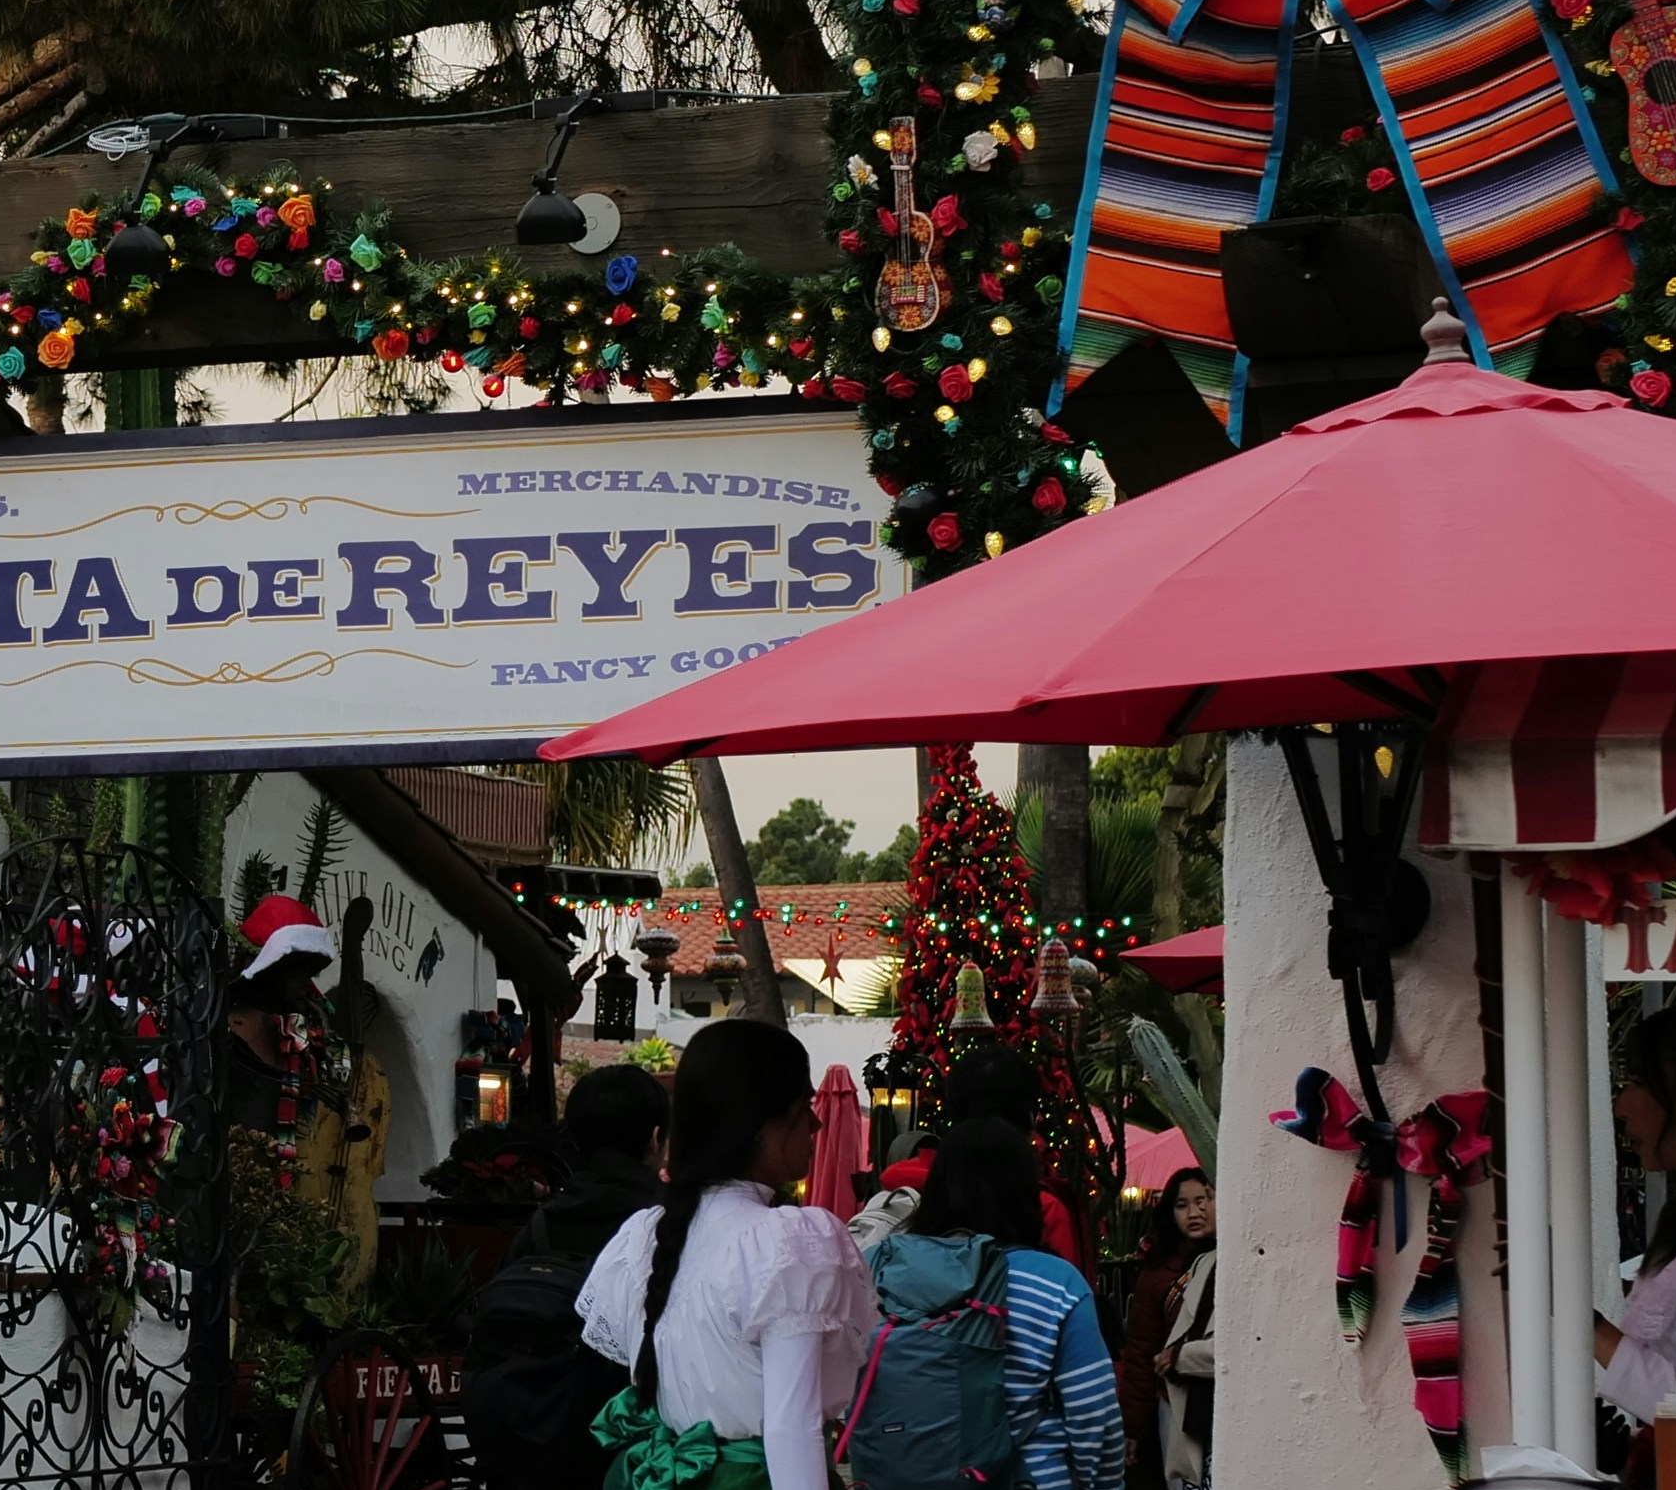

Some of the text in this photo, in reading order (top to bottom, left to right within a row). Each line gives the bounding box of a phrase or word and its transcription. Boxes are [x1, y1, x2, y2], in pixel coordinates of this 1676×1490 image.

[457, 470, 861, 512] MERCHANDISE.
[165, 558, 325, 630] DE
[490, 635, 806, 687] FANCY GOO
[381, 881, 418, 951] OIL
